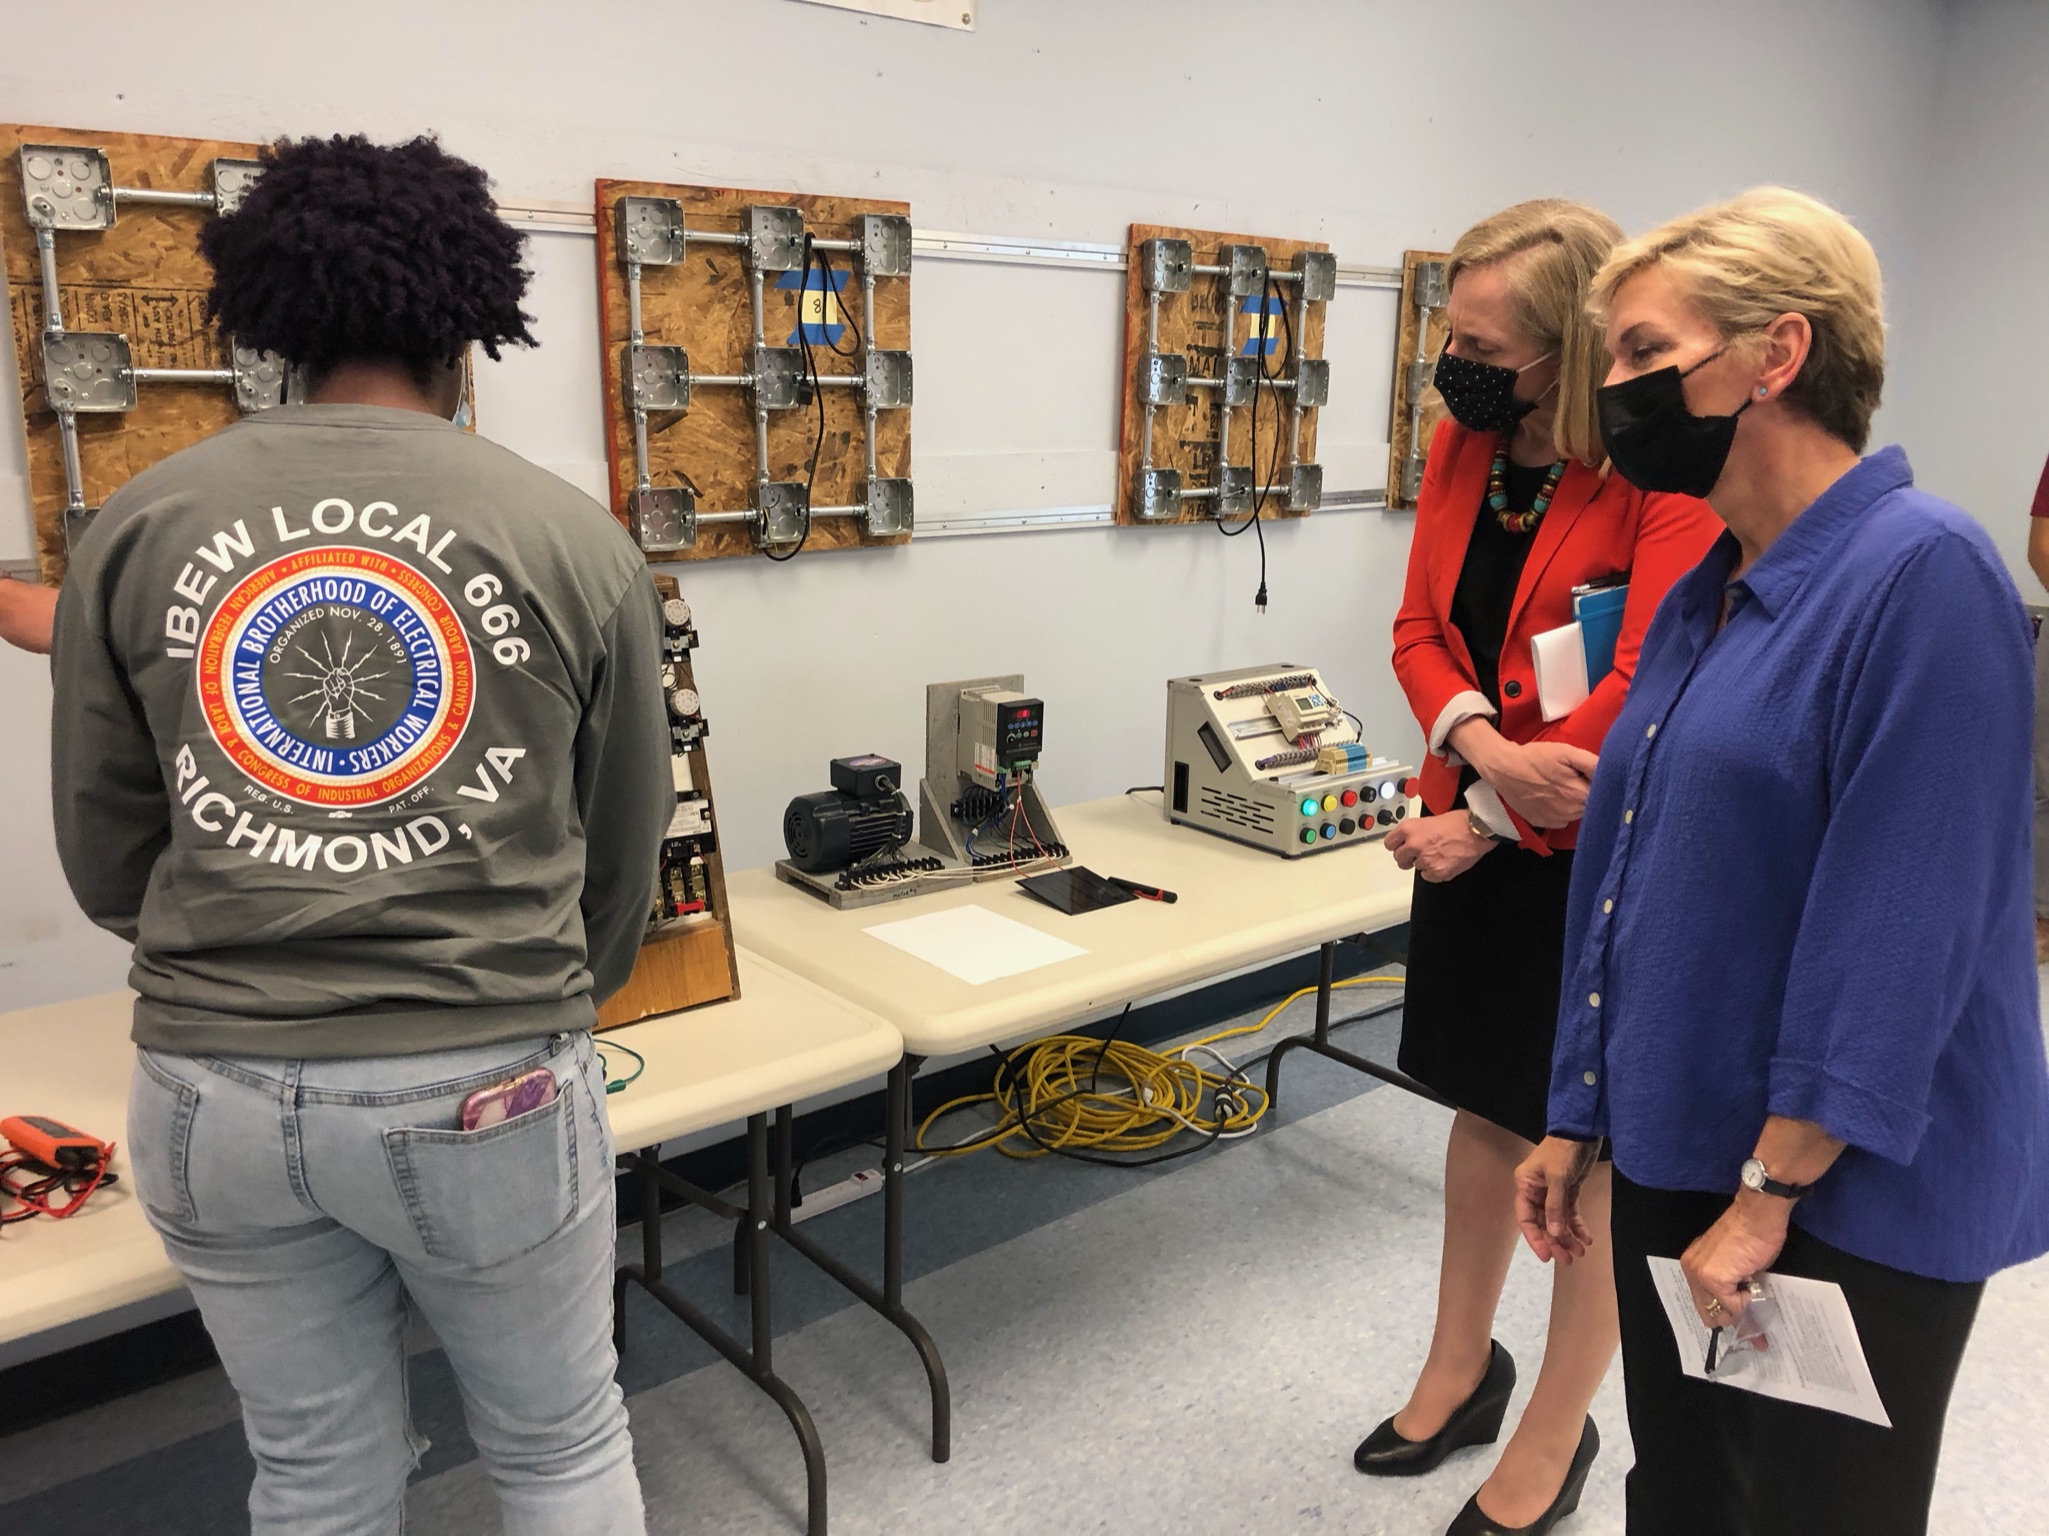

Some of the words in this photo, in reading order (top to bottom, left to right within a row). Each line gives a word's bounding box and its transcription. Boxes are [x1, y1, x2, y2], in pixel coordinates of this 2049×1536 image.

[813, 298, 822, 313] 8
[166, 519, 255, 658] IBEW
[272, 498, 457, 575] LOCAL
[464, 573, 530, 665] 666
[292, 552, 355, 571] AFFILIATED
[361, 553, 388, 572] WITH
[229, 569, 276, 611] AMERICAN
[370, 590, 398, 615] OF
[398, 570, 442, 612] CONGRESS
[242, 579, 366, 654] BROTHERHOOD
[270, 608, 324, 664] ORGANIZED
[330, 606, 362, 622] NOV.
[367, 617, 383, 636] 28,
[386, 636, 406, 664] 1891
[440, 614, 464, 654] LABOUR
[204, 613, 233, 674] FEDERATION
[392, 609, 439, 709] ELECTRICAL
[205, 682, 218, 696] OF
[452, 660, 468, 716] CANADIAN
[209, 703, 232, 735] LABOR
[237, 661, 333, 772] INTERNATIONAL
[447, 722, 459, 730] &
[227, 738, 238, 748] &
[350, 713, 427, 772] WORKERS
[382, 734, 452, 792] ORGANIZATIONS
[238, 750, 291, 789] CONGRESS
[296, 783, 311, 796] OF
[176, 744, 472, 872] RICHMOND,
[456, 748, 526, 803] VA
[244, 784, 268, 804] REG.
[272, 800, 294, 814] U.S.
[389, 802, 410, 814] PAT.
[411, 786, 434, 803] OFF.
[318, 786, 378, 802] INDUSTRIAL
